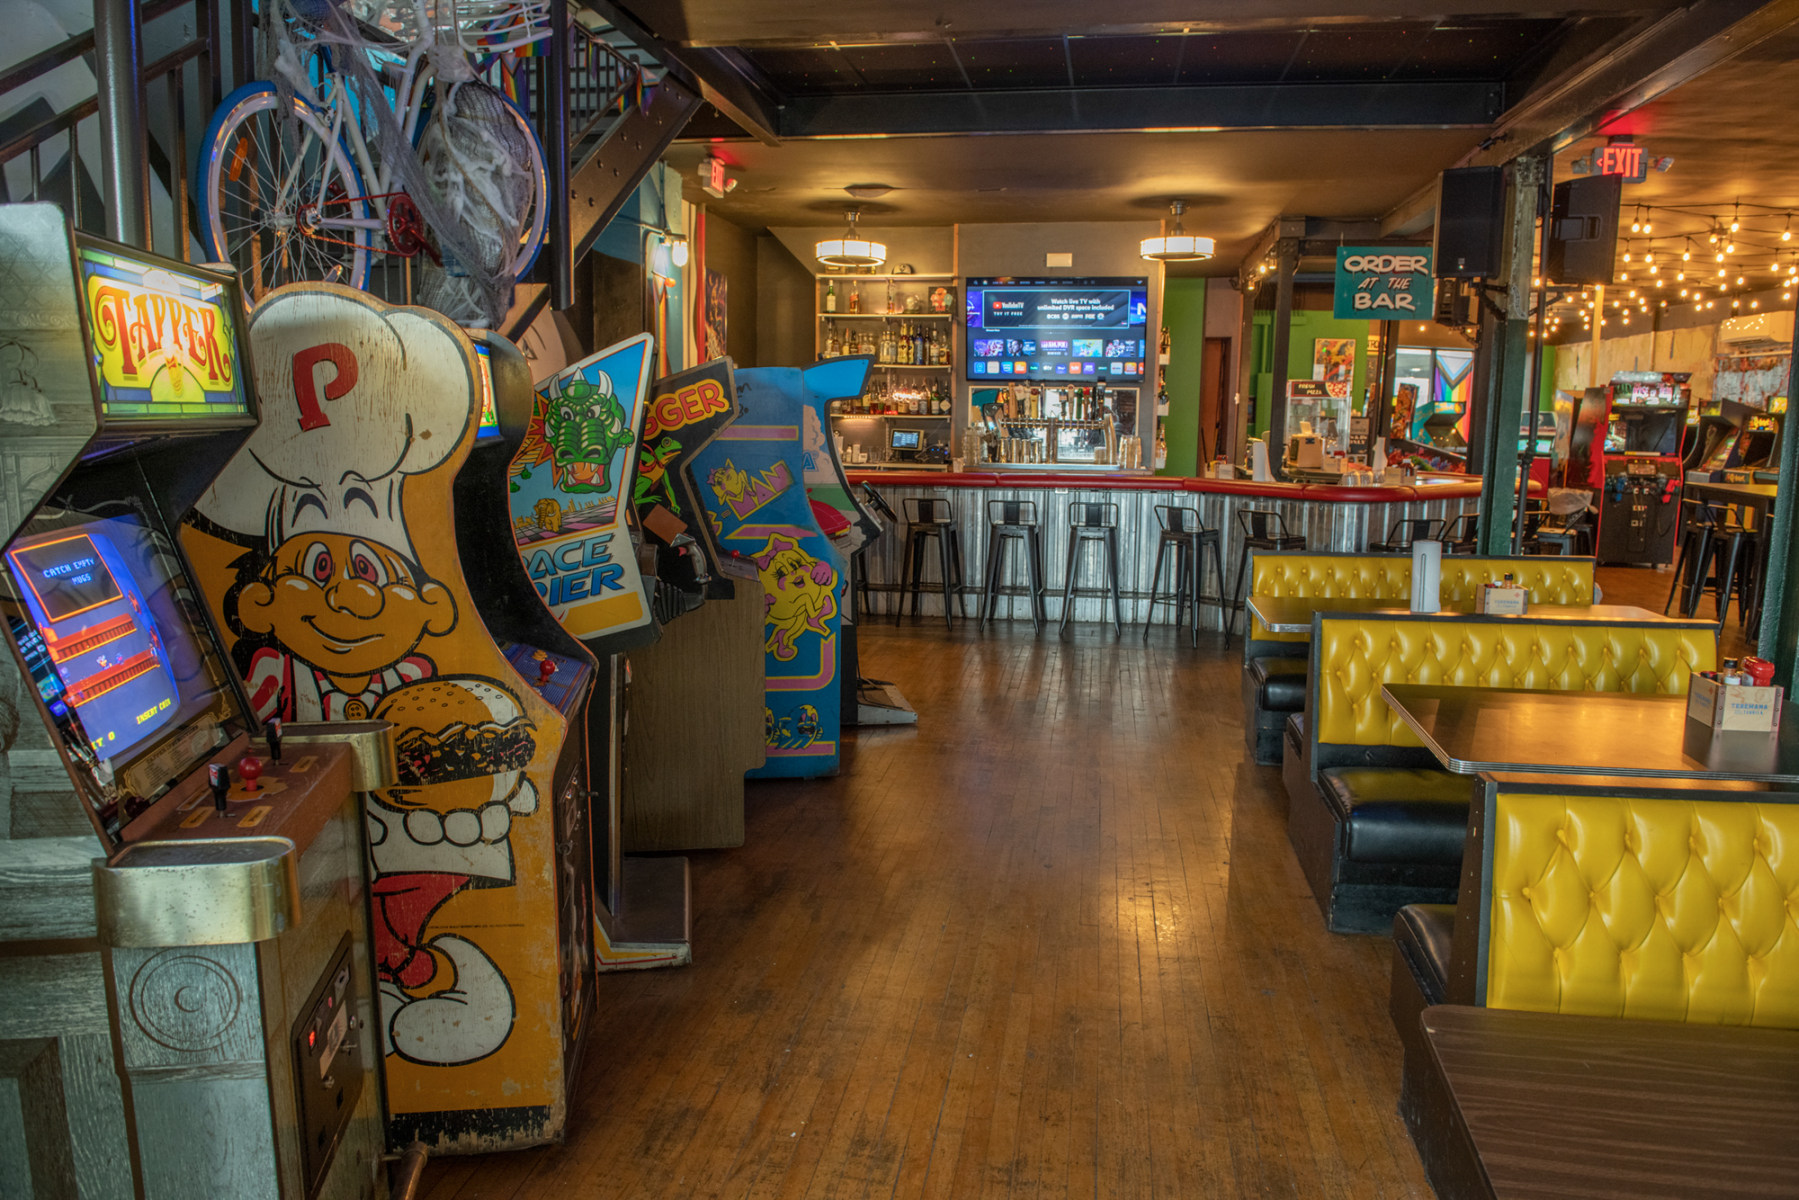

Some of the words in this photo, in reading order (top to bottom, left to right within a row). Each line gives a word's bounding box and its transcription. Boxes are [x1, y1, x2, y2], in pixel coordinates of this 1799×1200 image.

[1602, 147, 1643, 177] EXIT
[1343, 255, 1429, 275] ORDER
[1357, 277, 1380, 290] AT
[1388, 277, 1412, 290] THE
[1354, 292, 1417, 310] BAR
[95, 285, 232, 383] TAPPER
[291, 342, 359, 433] P
[521, 532, 616, 580] ACE
[43, 564, 73, 579] CATCH
[73, 558, 95, 570] EMPTY
[72, 572, 93, 585] MUGS
[136, 705, 158, 725] INSERT
